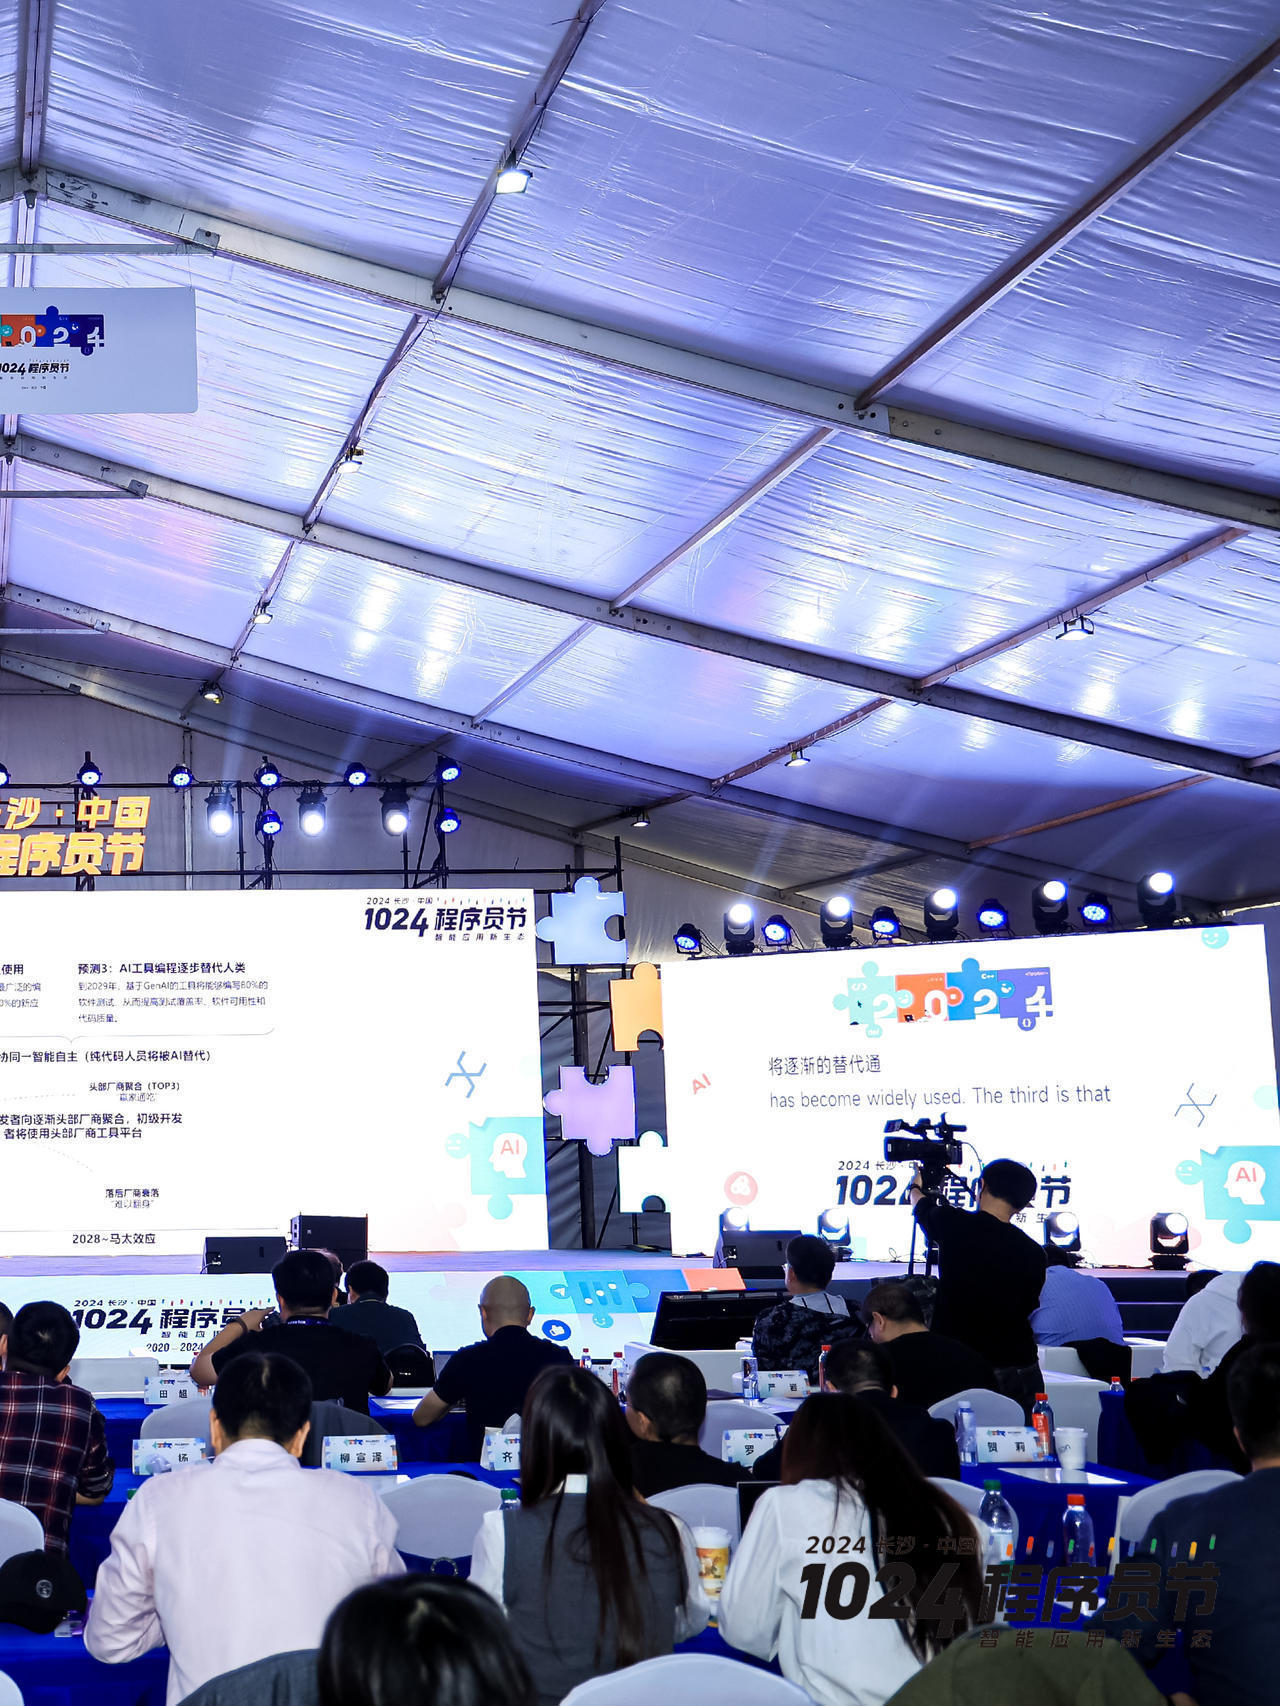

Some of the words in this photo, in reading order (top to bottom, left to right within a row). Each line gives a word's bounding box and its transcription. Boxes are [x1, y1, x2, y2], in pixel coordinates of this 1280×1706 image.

[28, 362, 70, 374] 程序员节
[367, 897, 389, 905] 2024
[365, 908, 429, 937] 1024
[434, 907, 527, 930] 程序员节
[78, 962, 245, 974] 预测3：AI工具编程逐步替代人类
[872, 986, 1054, 1020] 2024
[769, 1055, 880, 1075] 将逐渐的替代通
[692, 1073, 711, 1095] AI
[771, 1093, 795, 1107] has
[801, 1092, 860, 1109] become
[867, 1089, 916, 1110] widely
[924, 1088, 965, 1105] used.
[972, 1087, 1002, 1103] The
[1010, 1085, 1048, 1103] third
[1056, 1085, 1071, 1102] is
[1076, 1085, 1112, 1102] that
[4, 1127, 142, 1139] 者将使用头部厂商工具平台
[500, 1139, 520, 1155] AI
[839, 1161, 869, 1170] 2024
[1236, 1167, 1257, 1182] AI
[74, 1299, 104, 1307] 2024
[73, 1309, 153, 1335] 1024
[160, 1307, 265, 1329] 程序员
[146, 1342, 170, 1352] 2020
[180, 1342, 204, 1352] 2024
[745, 1445, 755, 1456] 罗
[340, 1452, 383, 1464] 柳宣泽
[502, 1451, 513, 1463] 齐
